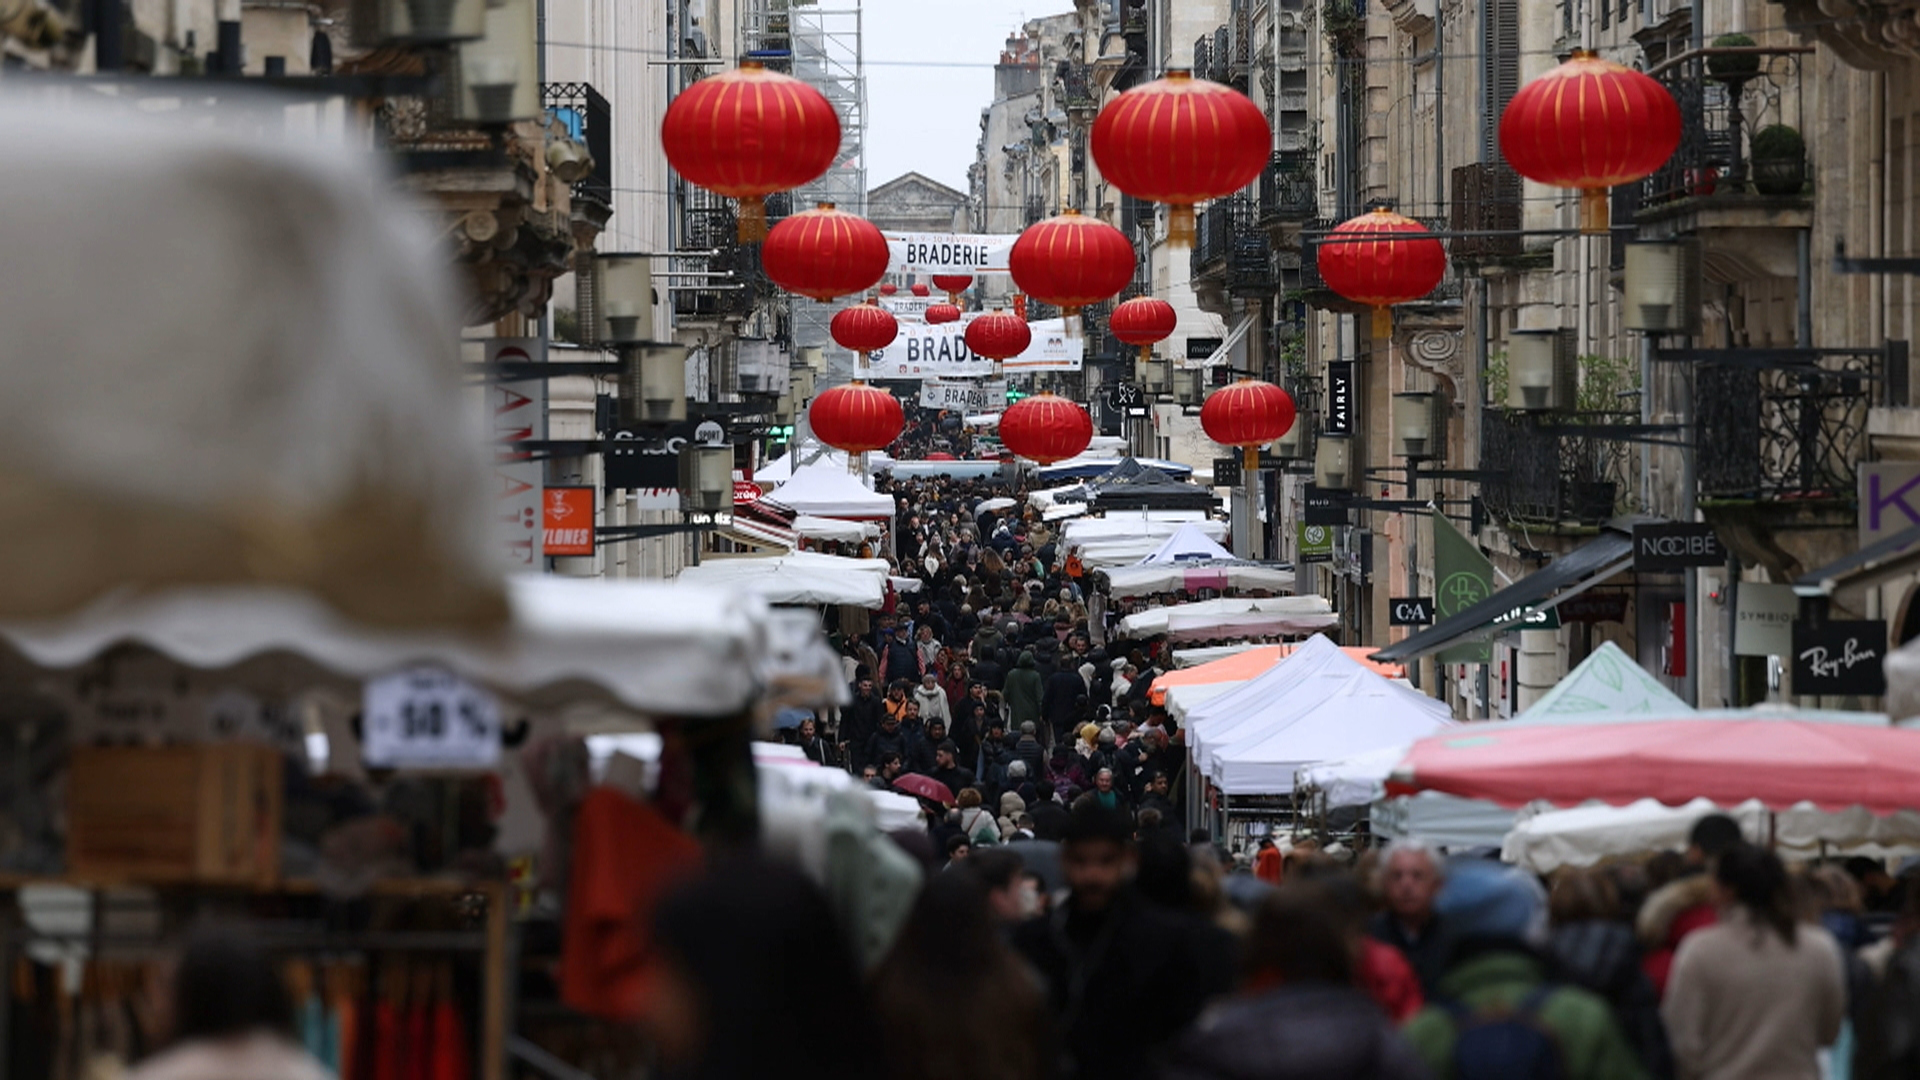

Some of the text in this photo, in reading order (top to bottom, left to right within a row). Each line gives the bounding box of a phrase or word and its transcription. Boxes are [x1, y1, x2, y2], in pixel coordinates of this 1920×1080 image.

[907, 243, 989, 266] BRADERIE
[1335, 377, 1346, 428] FAIRLY
[698, 429, 721, 441] SPORT
[542, 528, 590, 546] YLONES
[1641, 530, 1717, 556] NOCIBÉ
[1395, 603, 1427, 620] C&A
